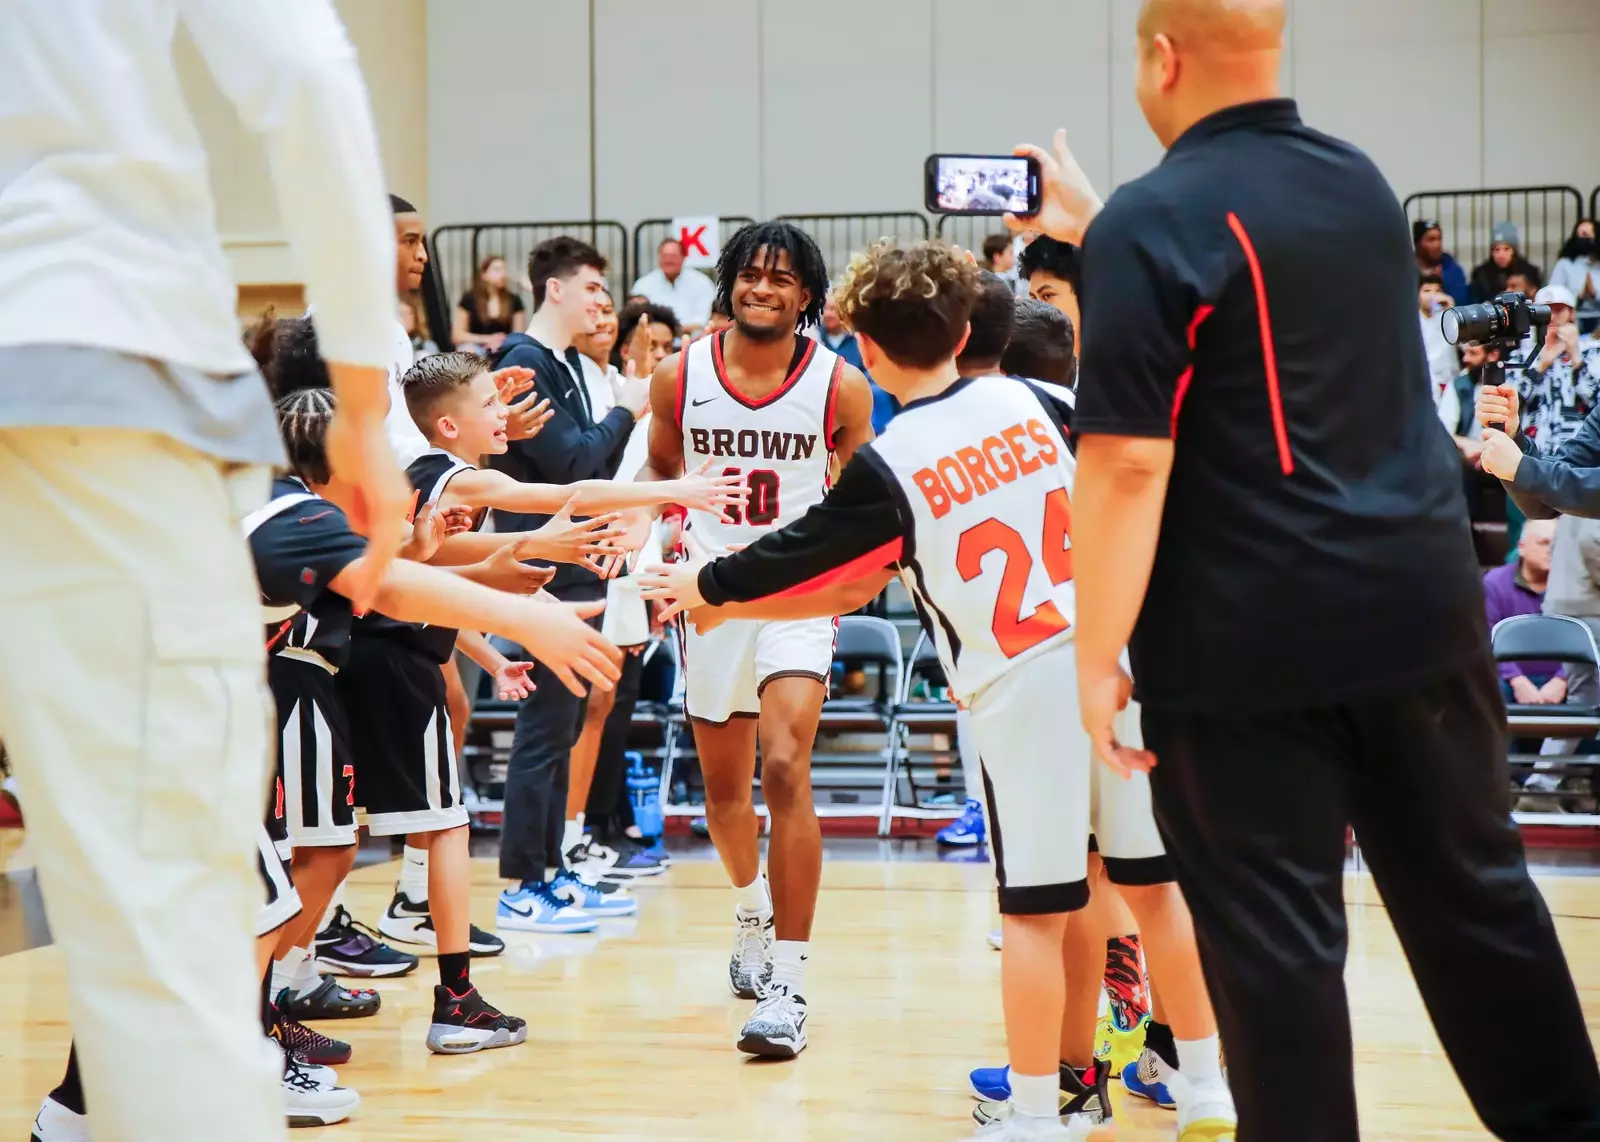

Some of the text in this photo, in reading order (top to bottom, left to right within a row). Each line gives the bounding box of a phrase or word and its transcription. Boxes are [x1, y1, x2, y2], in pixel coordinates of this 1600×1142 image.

[681, 226, 709, 256] K
[690, 428, 817, 461] BROWN
[912, 418, 1058, 520] BORGES
[721, 467, 780, 527] 10
